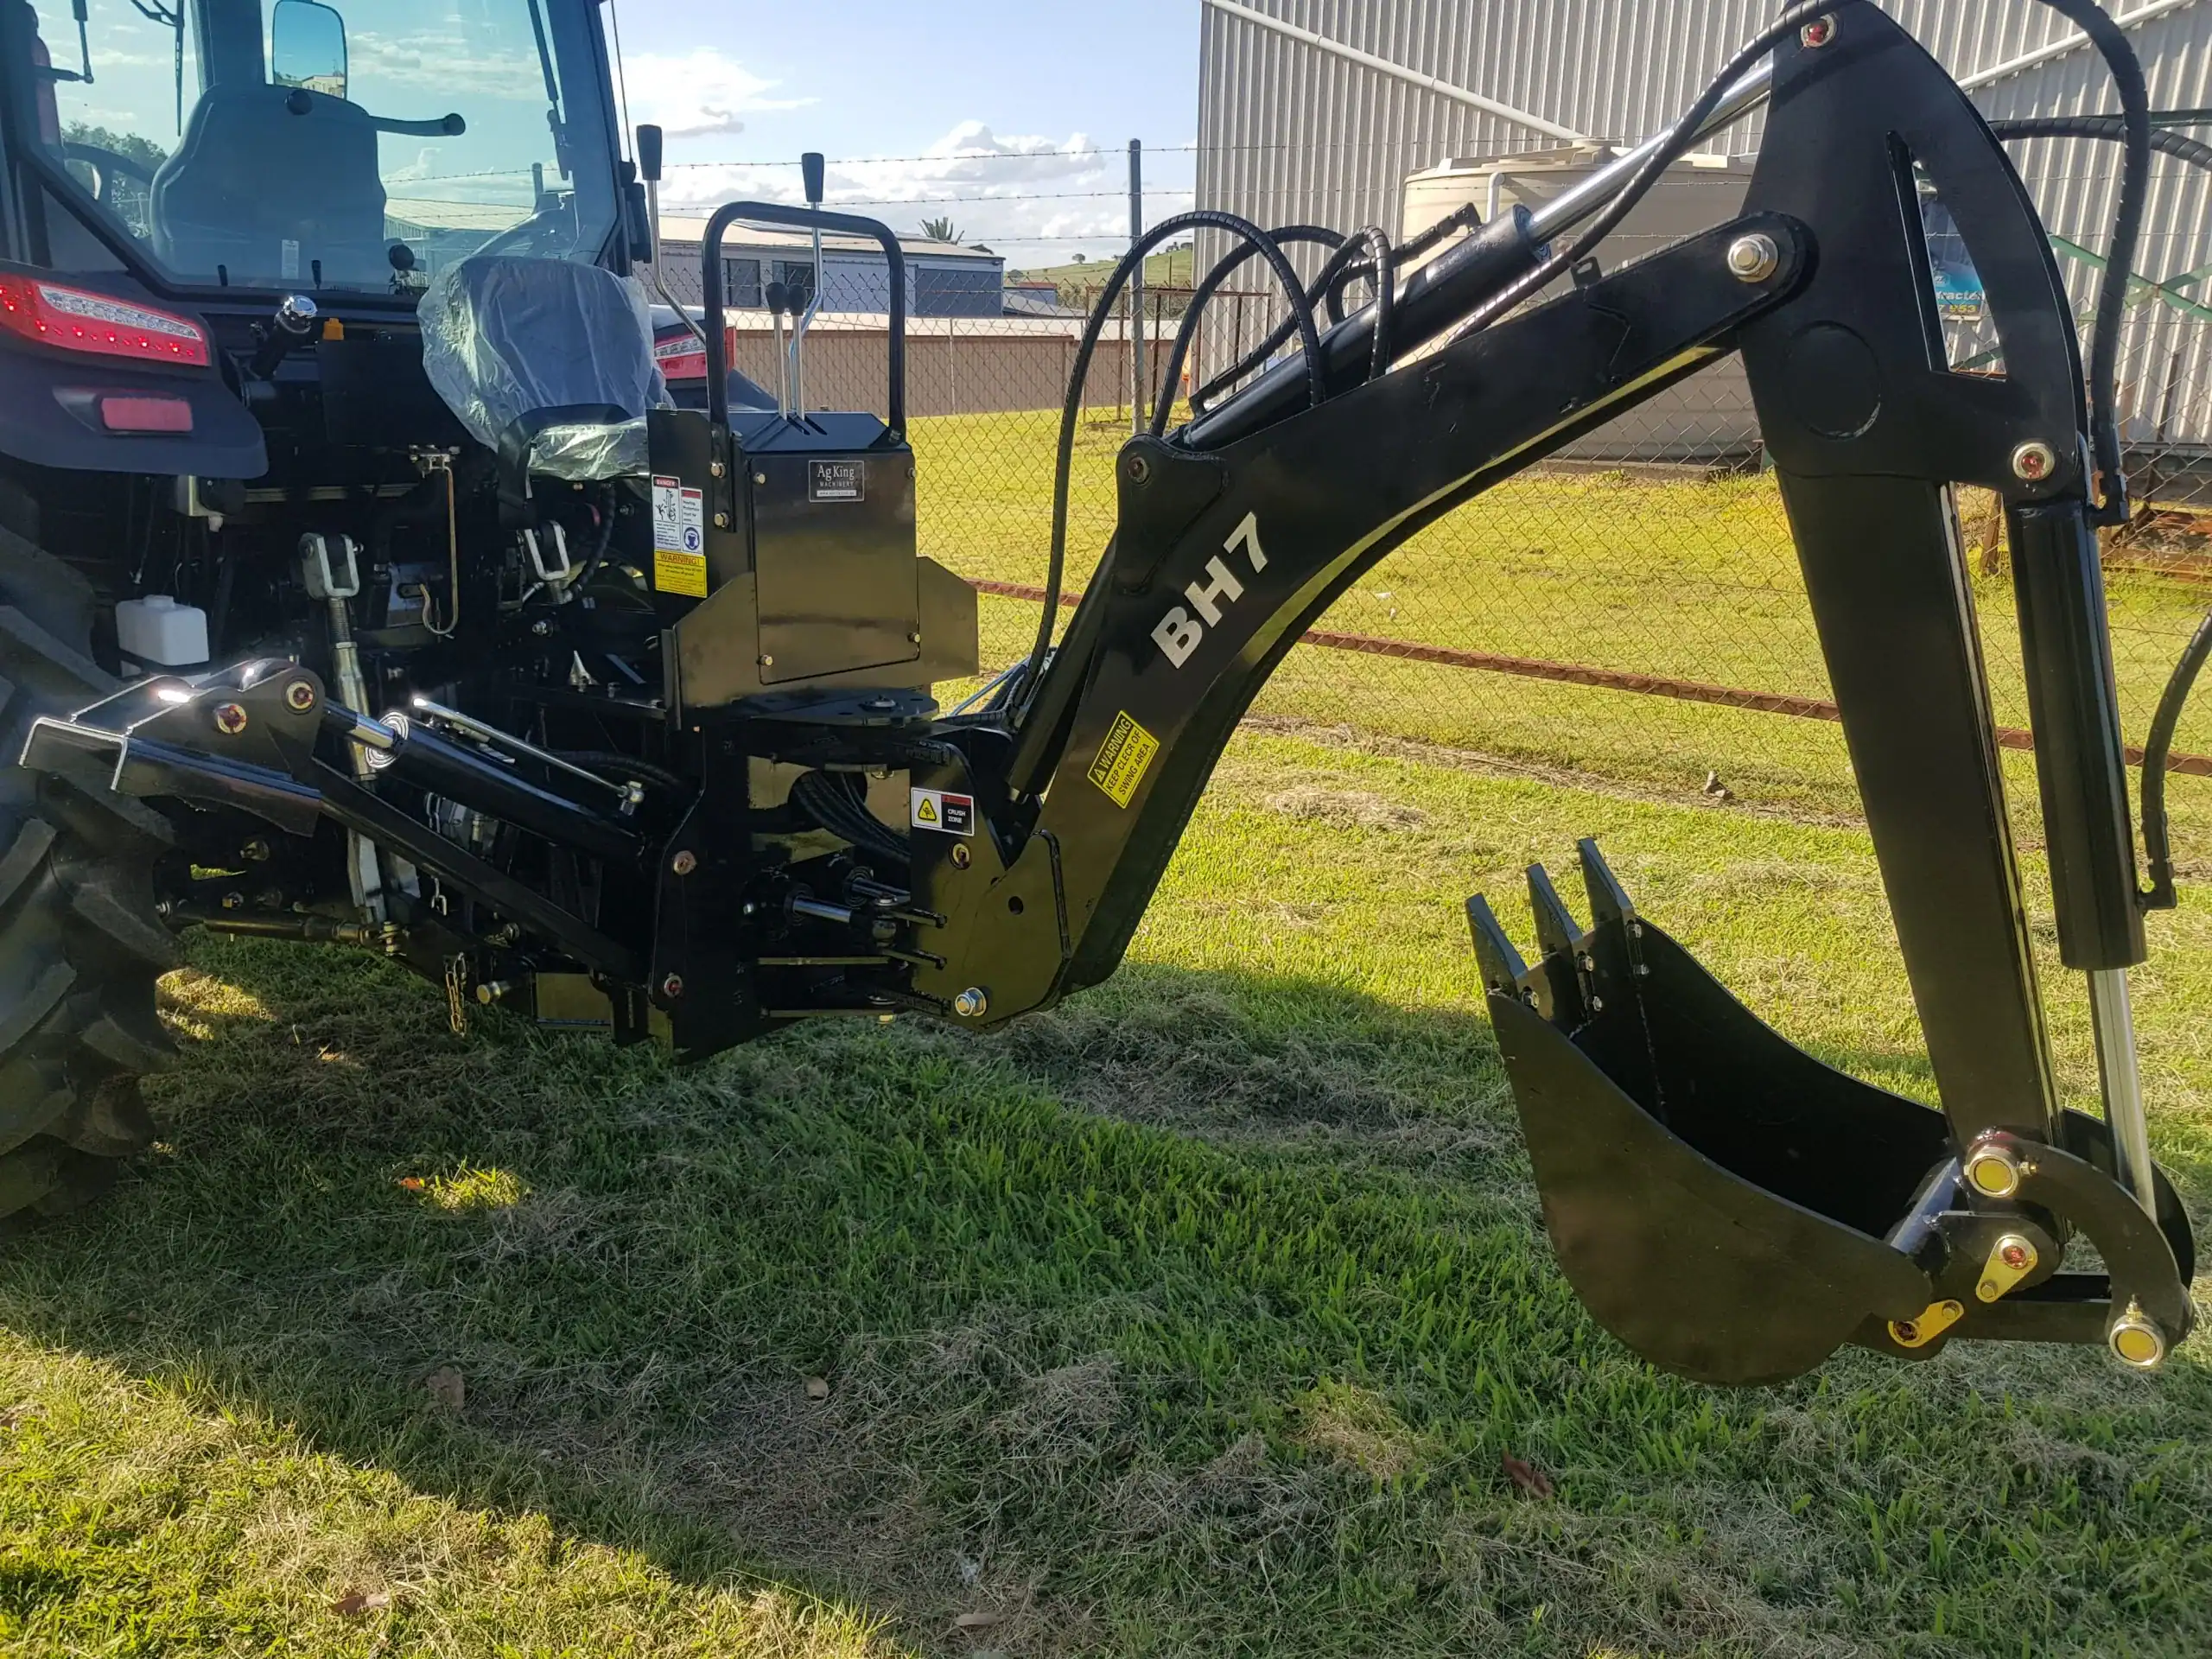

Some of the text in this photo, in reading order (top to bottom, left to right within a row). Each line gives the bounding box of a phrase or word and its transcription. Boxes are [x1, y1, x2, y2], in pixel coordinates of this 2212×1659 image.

[1150, 512, 1268, 669] BH7
[1099, 719, 1132, 769] WARNING
[1106, 770, 1120, 792] KEEP
[1132, 730, 1141, 744] OF
[1119, 743, 1150, 795] SWING AREA
